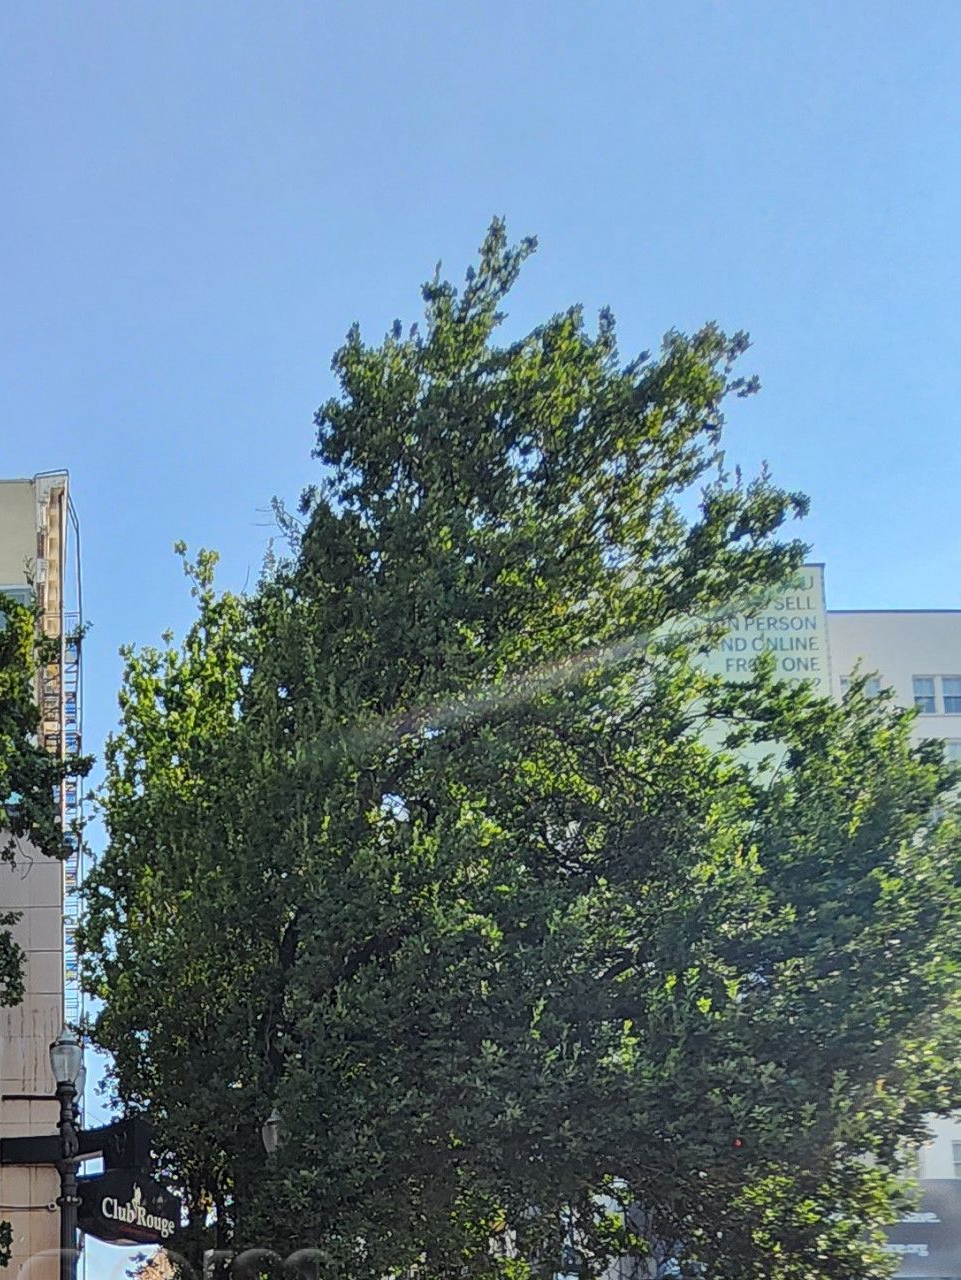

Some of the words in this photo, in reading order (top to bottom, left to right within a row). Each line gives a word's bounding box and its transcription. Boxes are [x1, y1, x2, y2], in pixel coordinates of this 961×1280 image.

[774, 596, 817, 611] SELL
[744, 616, 817, 632] PERSON
[721, 637, 748, 652] ND
[751, 636, 820, 652] ONLINE
[725, 657, 778, 673] FR
[781, 656, 821, 672] ONE
[101, 1196, 135, 1224] Club
[137, 1206, 175, 1238] Rouge
